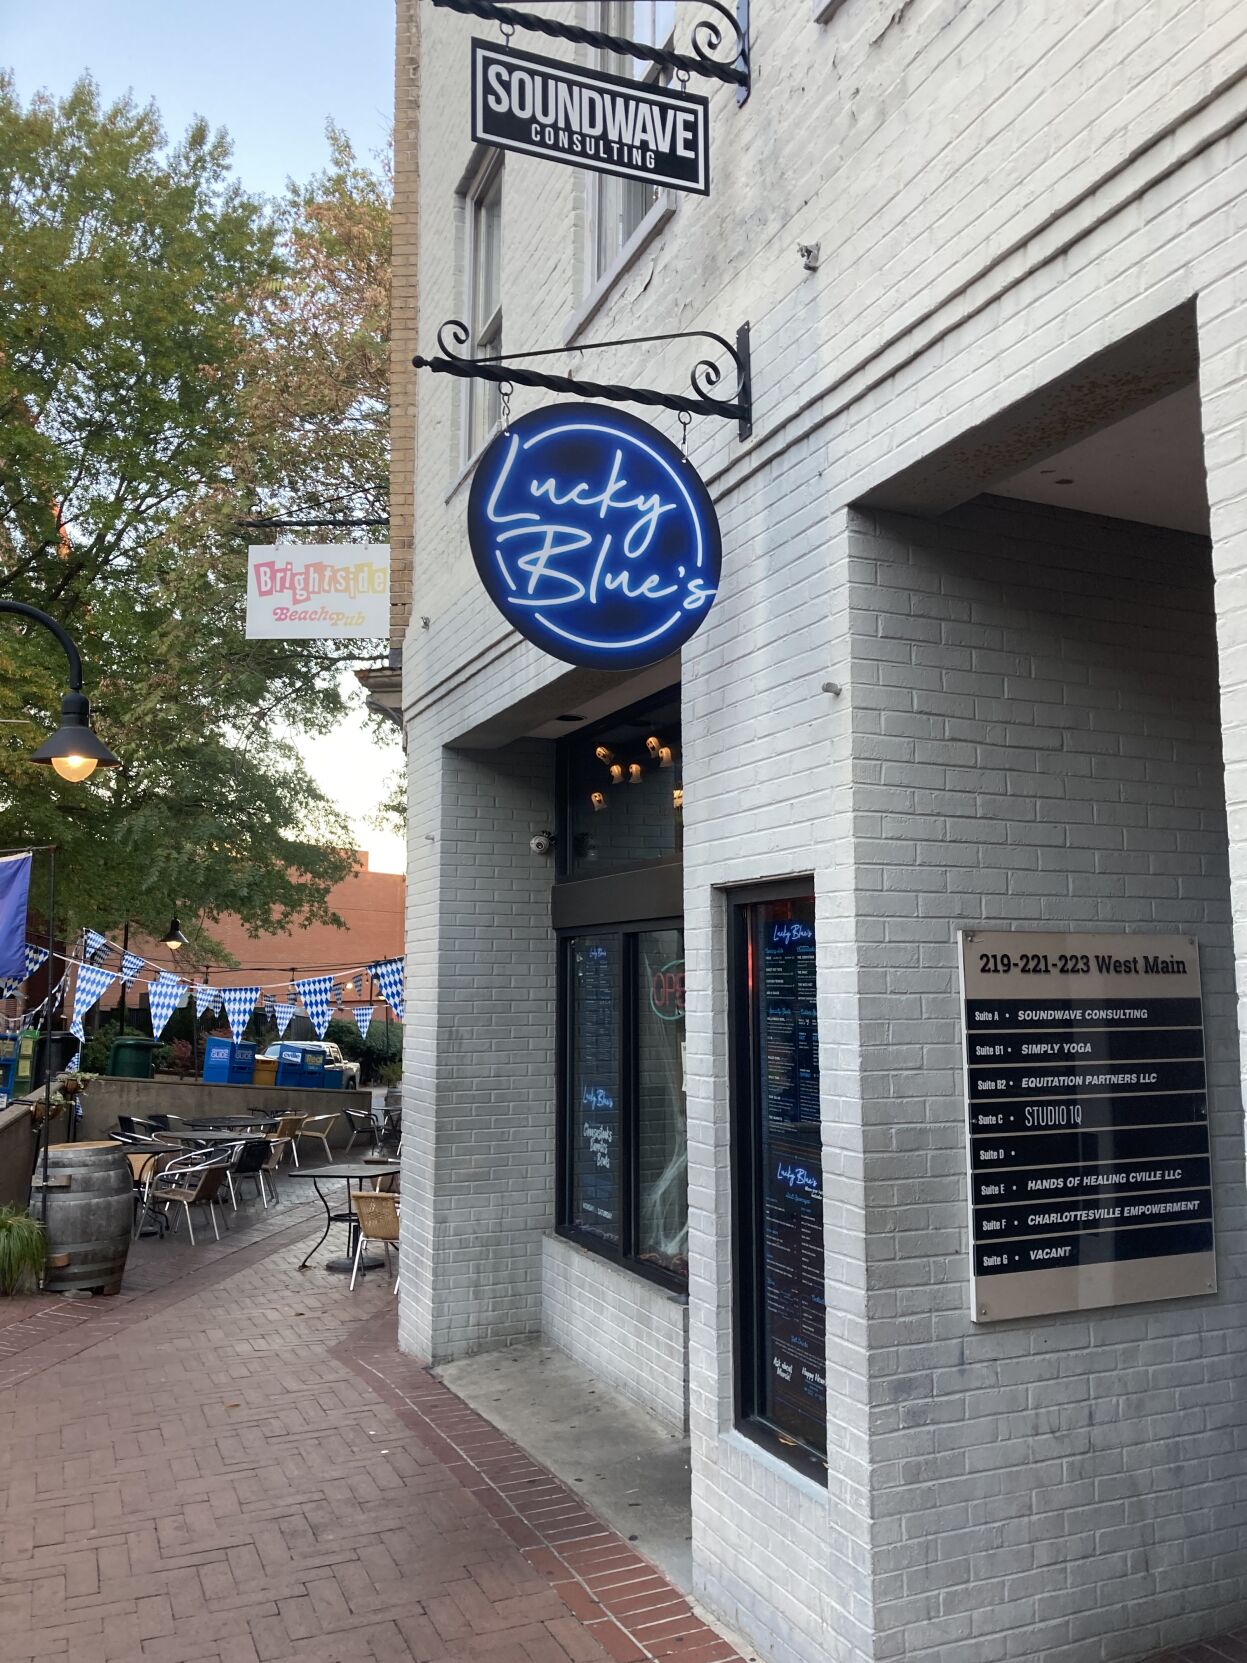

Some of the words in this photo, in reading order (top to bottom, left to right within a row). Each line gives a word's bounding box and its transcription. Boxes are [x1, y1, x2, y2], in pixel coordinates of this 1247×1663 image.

[487, 64, 695, 158] SOUNDWAVE
[532, 123, 655, 168] CONSULTING
[487, 434, 676, 558] Lucky
[497, 525, 718, 610] Blue's
[257, 562, 386, 602] Brightside
[272, 606, 330, 622] Beach
[329, 611, 366, 627] Pub
[979, 954, 1090, 974] 219-221-223
[1095, 955, 1139, 974] West
[1143, 954, 1187, 974] Main
[975, 1011, 993, 1021] Suite
[994, 1011, 999, 1021] A
[1018, 1010, 1083, 1020] SOUNDWAVE
[1085, 1009, 1148, 1019] CONSULTING
[976, 1045, 994, 1055] Suite
[995, 1045, 1004, 1055] B1
[1021, 1043, 1060, 1054] SIMPLY
[1063, 1043, 1092, 1053] YOGA
[977, 1079, 996, 1090] Suite
[996, 1079, 1006, 1089] B2
[1021, 1076, 1083, 1088] EQUITATION
[1085, 1074, 1138, 1085] PARTNERS
[1139, 1073, 1157, 1083] LLC
[978, 1114, 996, 1125] Suite
[997, 1114, 1003, 1124] C
[1025, 1106, 1067, 1126] STUDIO
[979, 1150, 998, 1160] Suite
[999, 1149, 1004, 1159] D
[981, 1185, 999, 1195] Suite
[1000, 1184, 1005, 1194] E
[1028, 1178, 1064, 1191] HANDS
[1067, 1177, 1080, 1187] OF
[1083, 1173, 1127, 1186] HEALING
[1129, 1171, 1162, 1182] CVILLE
[1164, 1169, 1182, 1180] LLC
[982, 1220, 1001, 1231] Suite
[1002, 1219, 1007, 1229] F
[1028, 1208, 1121, 1226] CHARLOTTESVILLE
[1123, 1200, 1200, 1217] EMPOWERMENT
[983, 1256, 1002, 1266] Suite
[1002, 1255, 1008, 1265] G
[1030, 1246, 1072, 1260] VACANT
